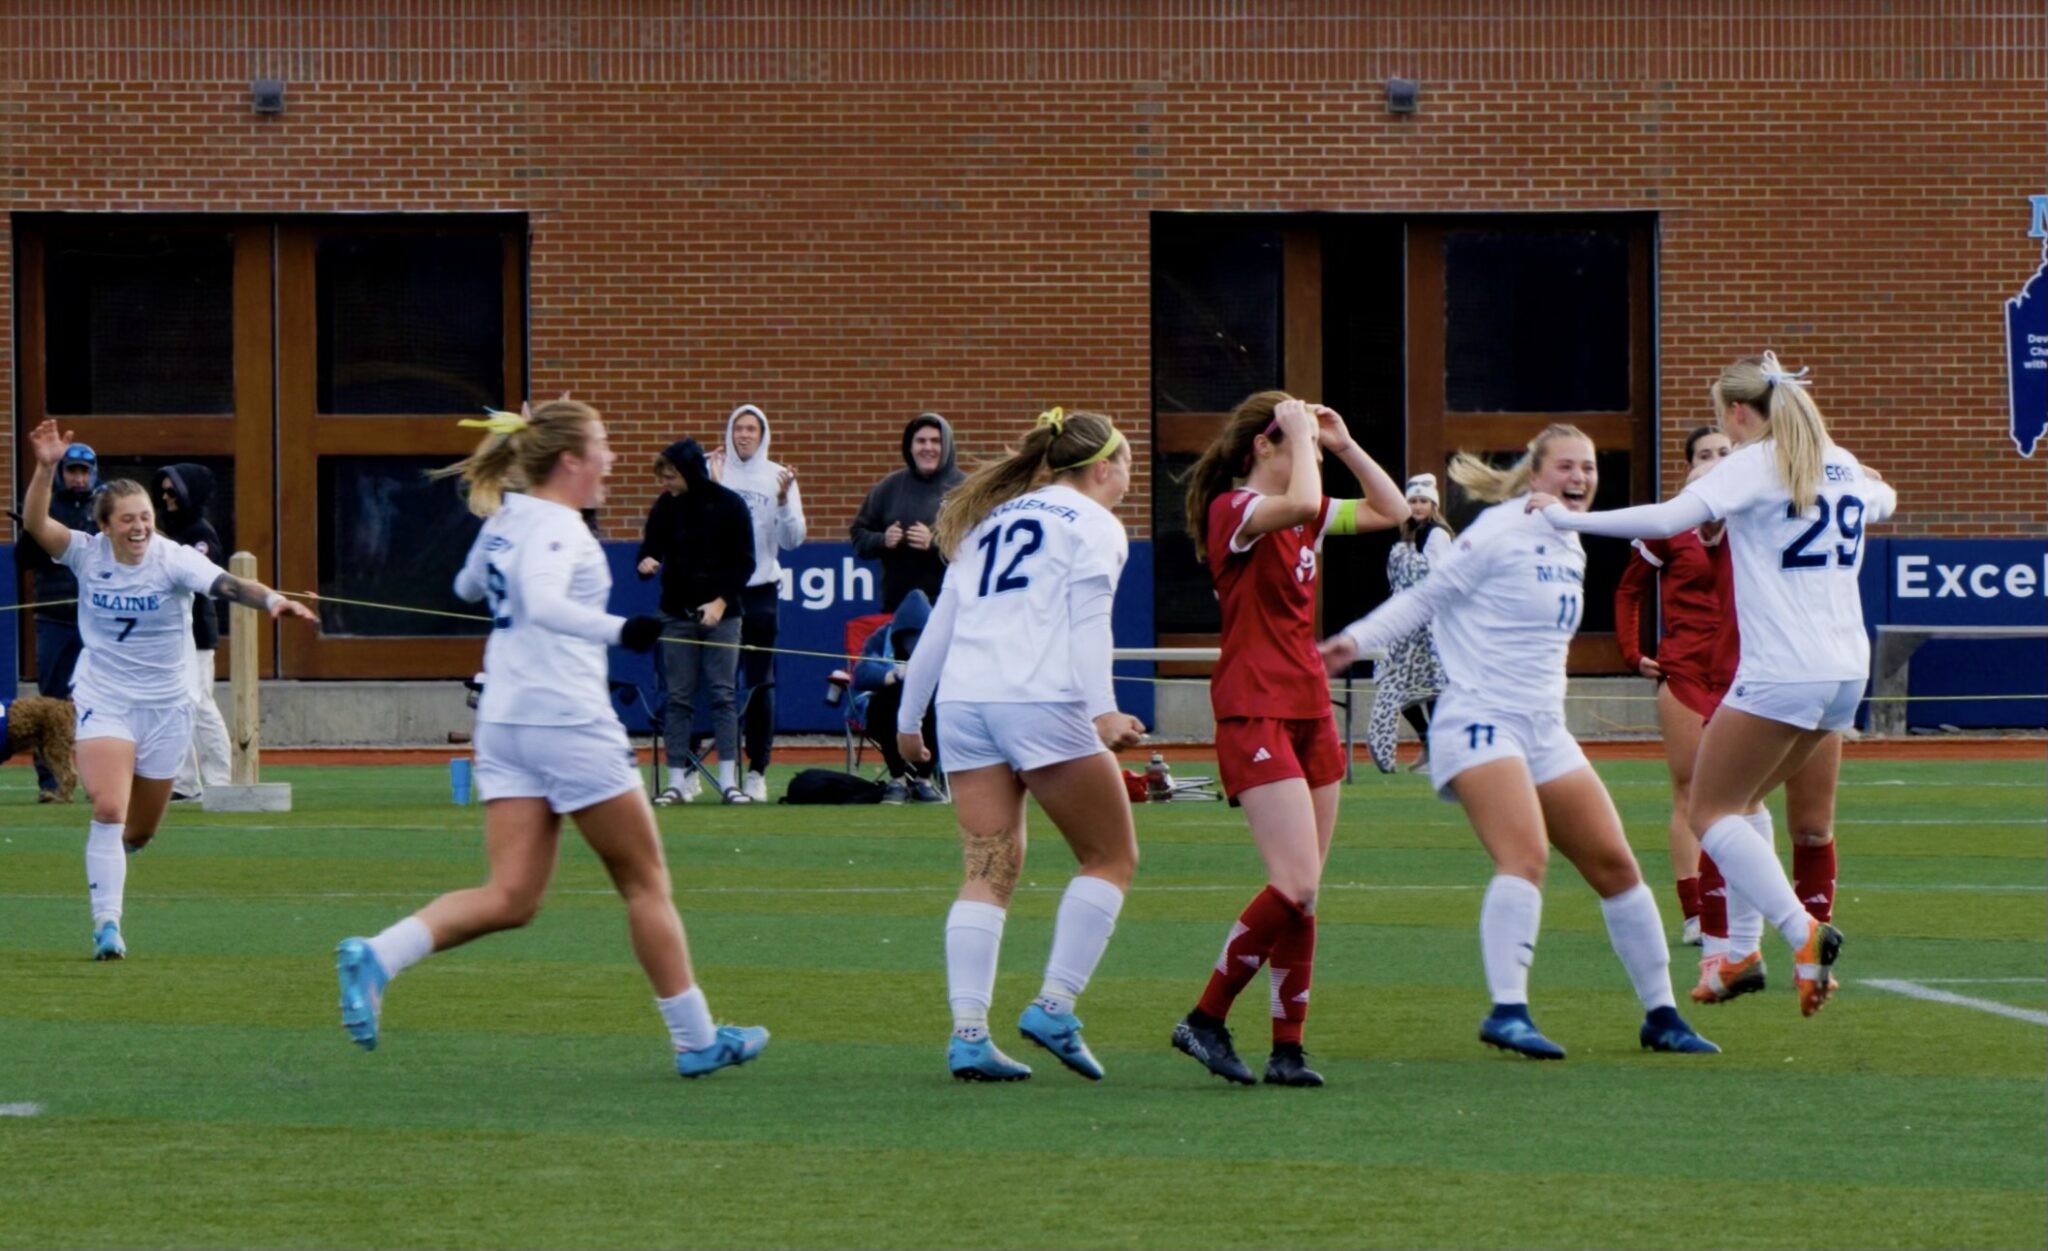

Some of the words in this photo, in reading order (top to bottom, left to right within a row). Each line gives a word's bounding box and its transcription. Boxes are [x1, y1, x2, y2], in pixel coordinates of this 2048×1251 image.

[1781, 494, 1865, 569] 29
[978, 518, 1043, 597] 12
[92, 593, 160, 611] MAINE
[1557, 593, 1577, 629] 11
[115, 616, 138, 642] 7
[1465, 722, 1495, 749] 11
